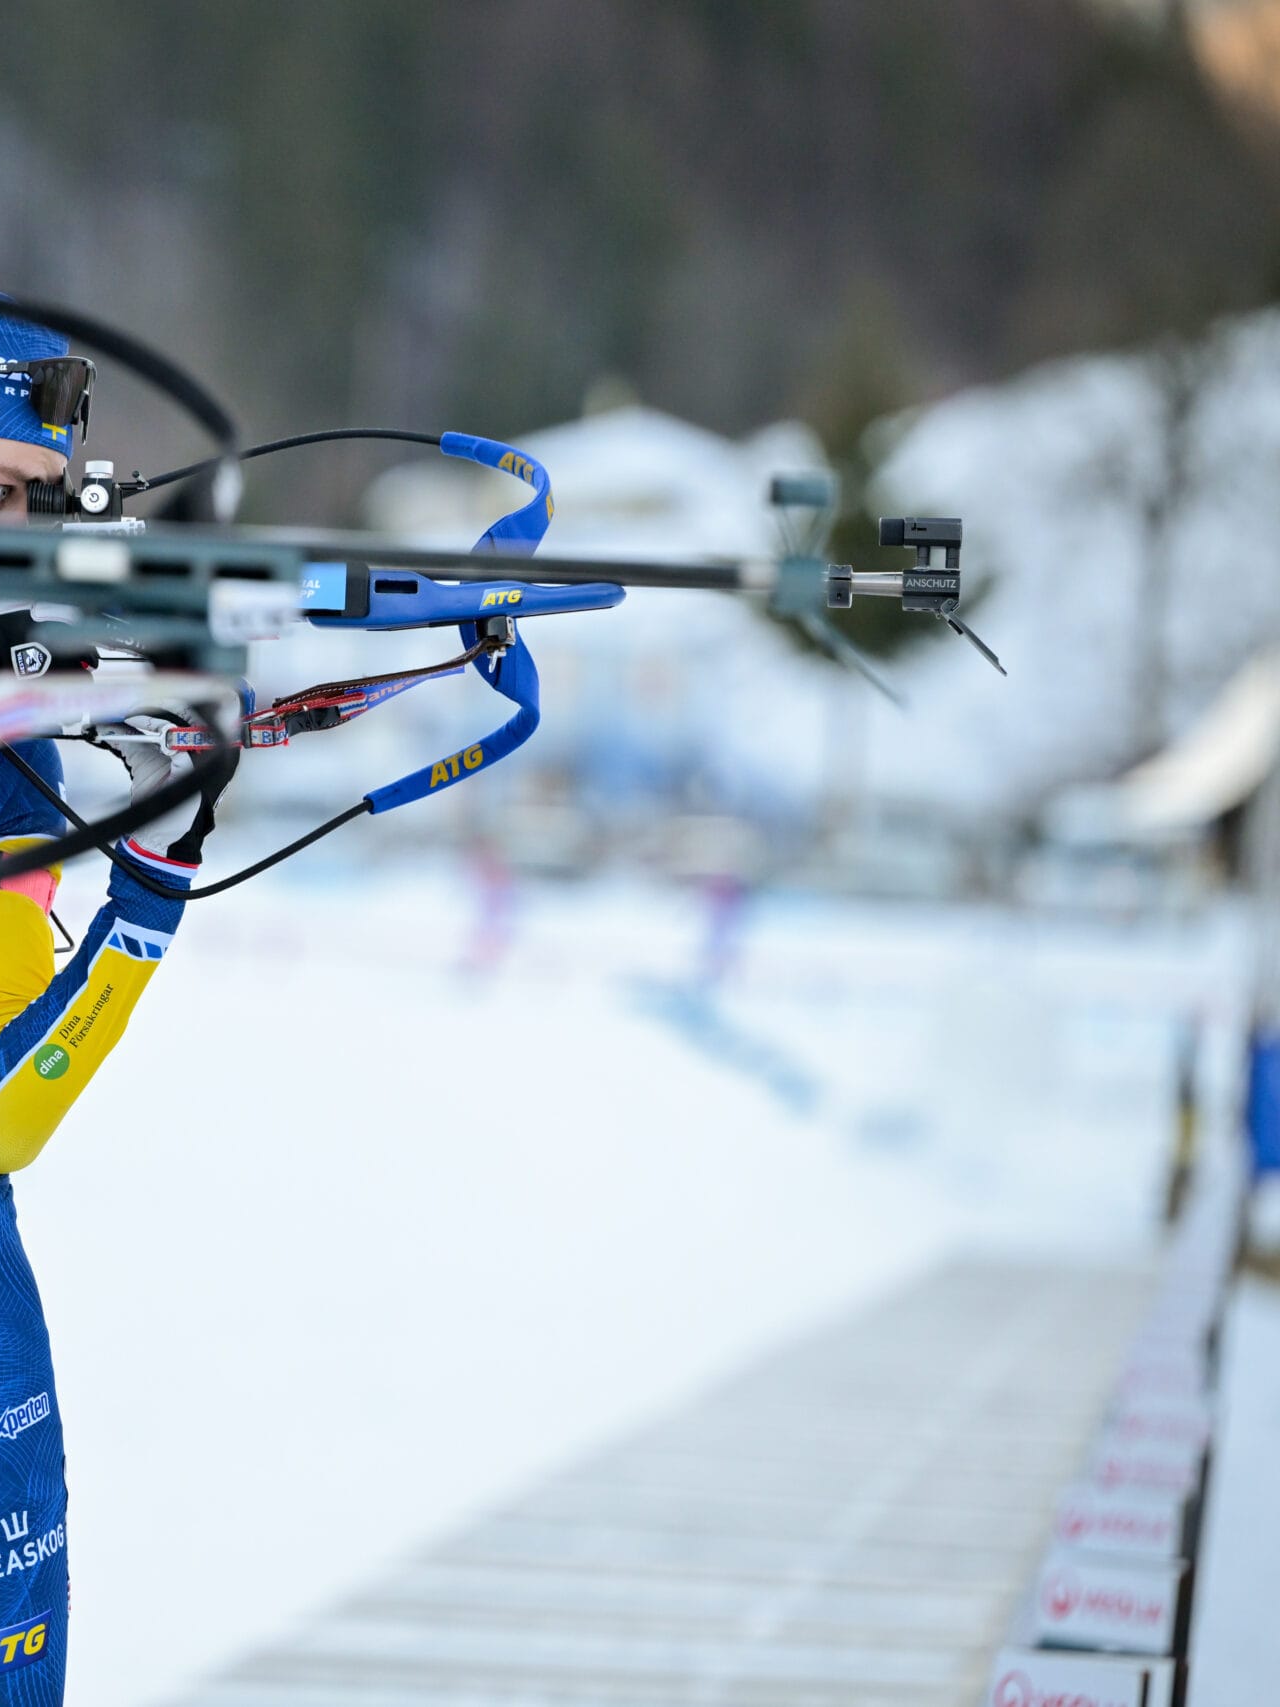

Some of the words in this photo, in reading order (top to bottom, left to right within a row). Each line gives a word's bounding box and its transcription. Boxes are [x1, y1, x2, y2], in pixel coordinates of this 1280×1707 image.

[498, 451, 535, 484] ATG
[483, 589, 522, 606] ATG
[430, 743, 484, 788] ATG
[59, 1015, 81, 1040] Dina
[69, 983, 114, 1048] Försäkringar
[40, 1049, 64, 1075] dina
